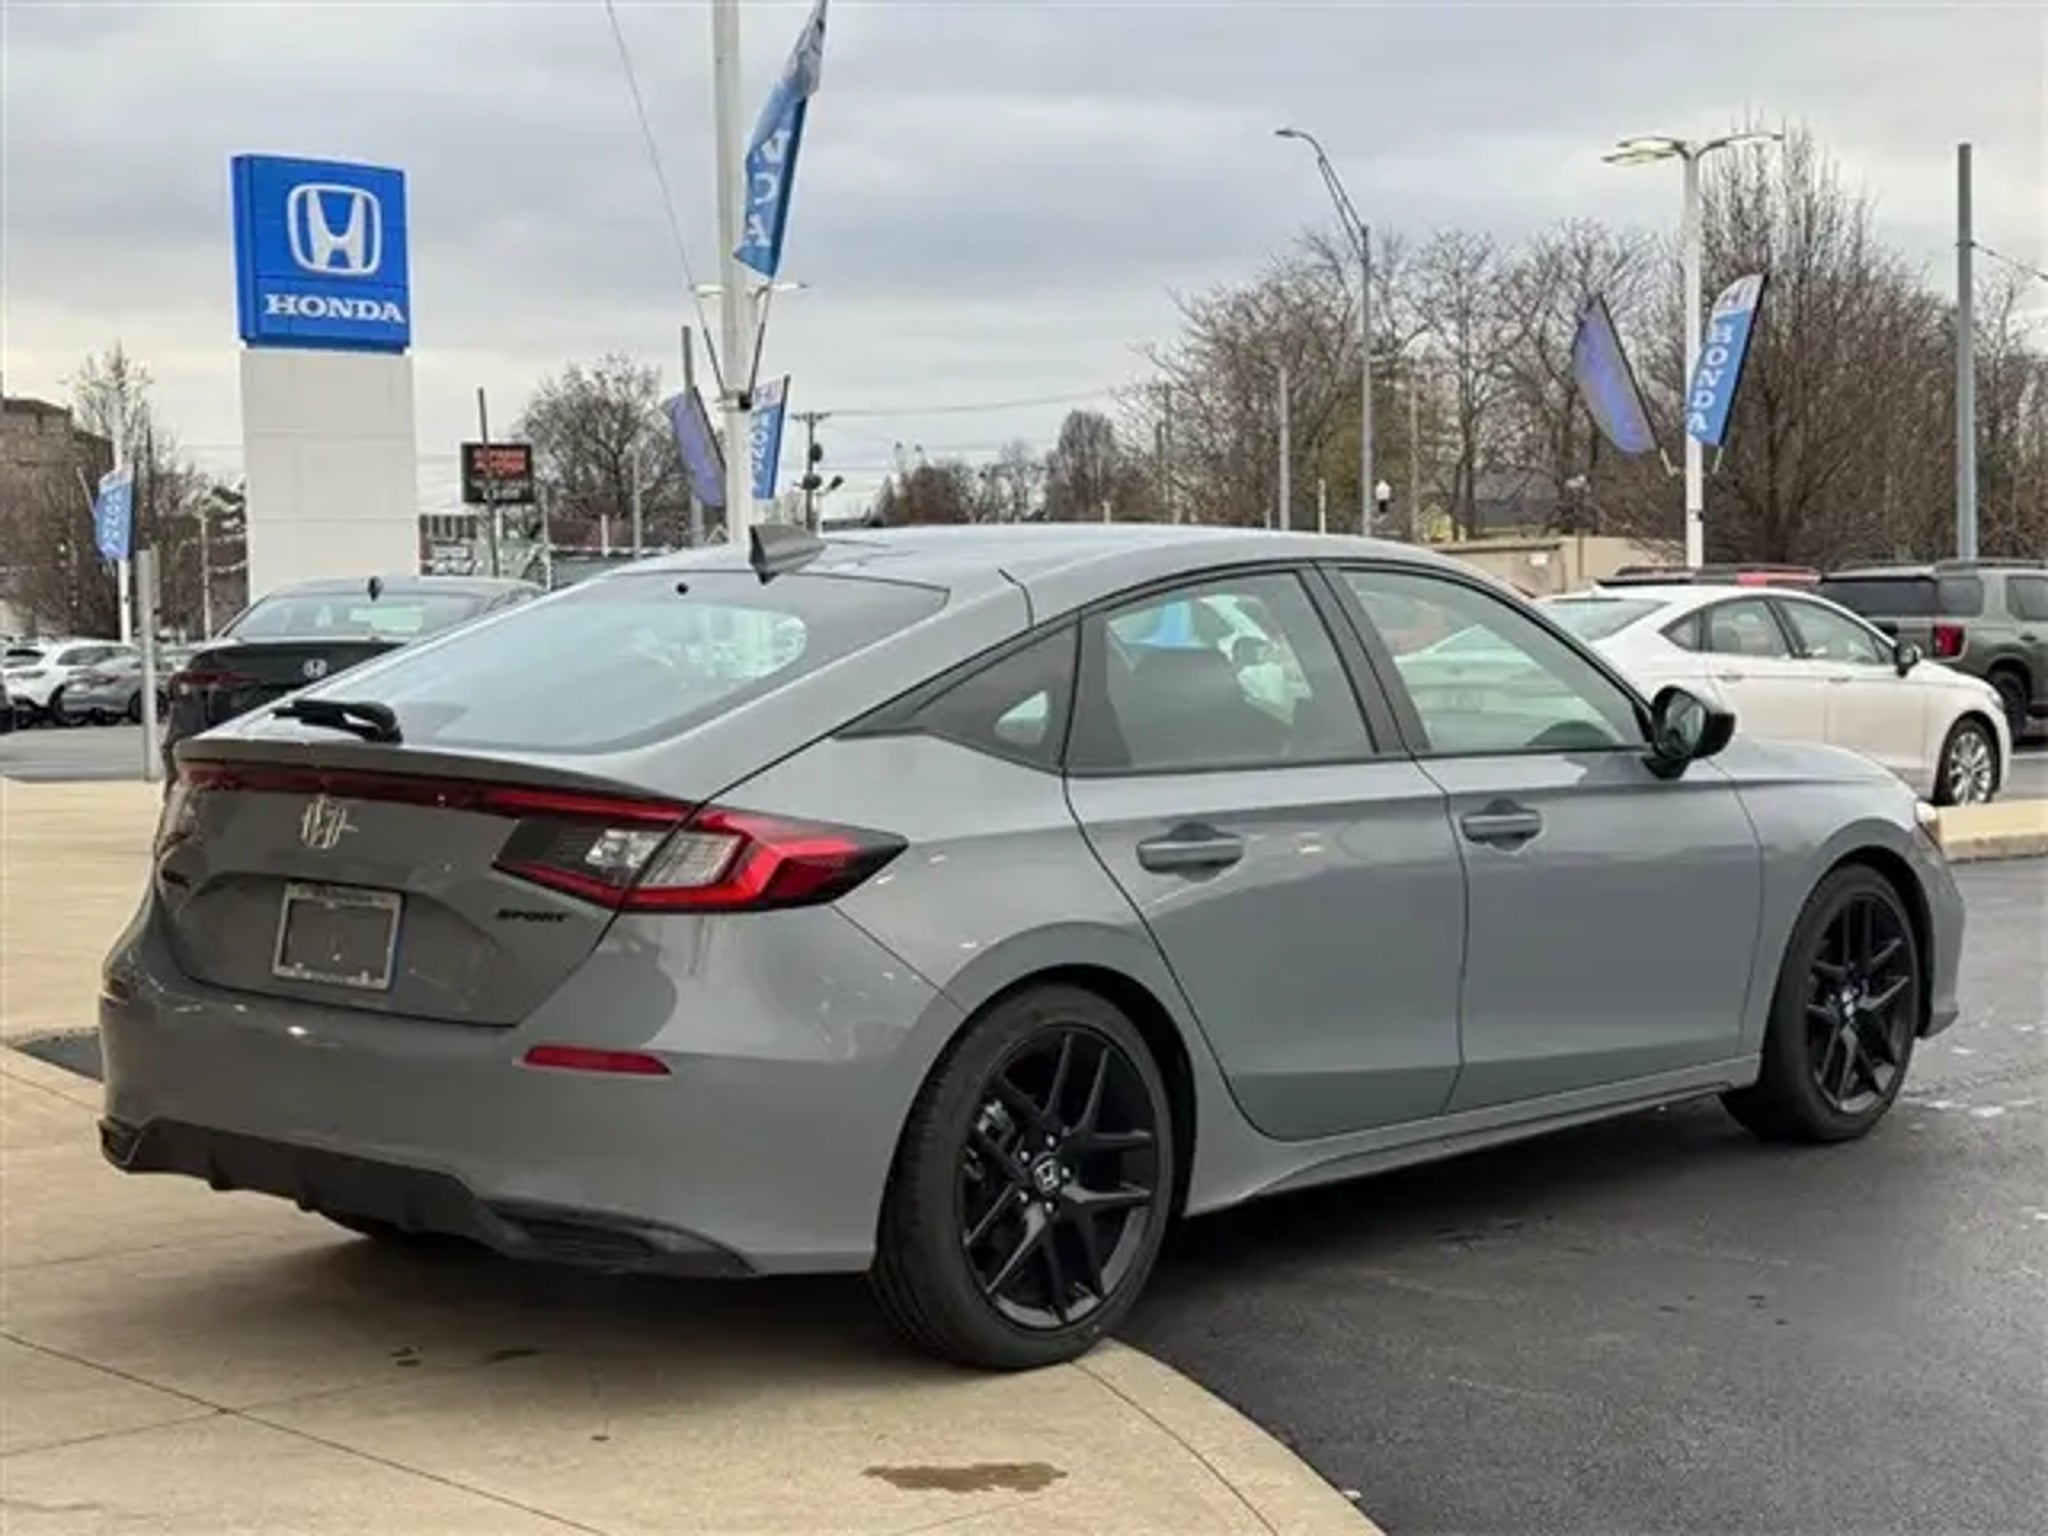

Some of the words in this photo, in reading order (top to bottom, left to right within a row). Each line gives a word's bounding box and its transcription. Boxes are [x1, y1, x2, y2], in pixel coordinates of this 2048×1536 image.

[264, 293, 407, 324] HONDA
[1687, 323, 1734, 433] HONDA
[496, 907, 571, 923] SPORT
